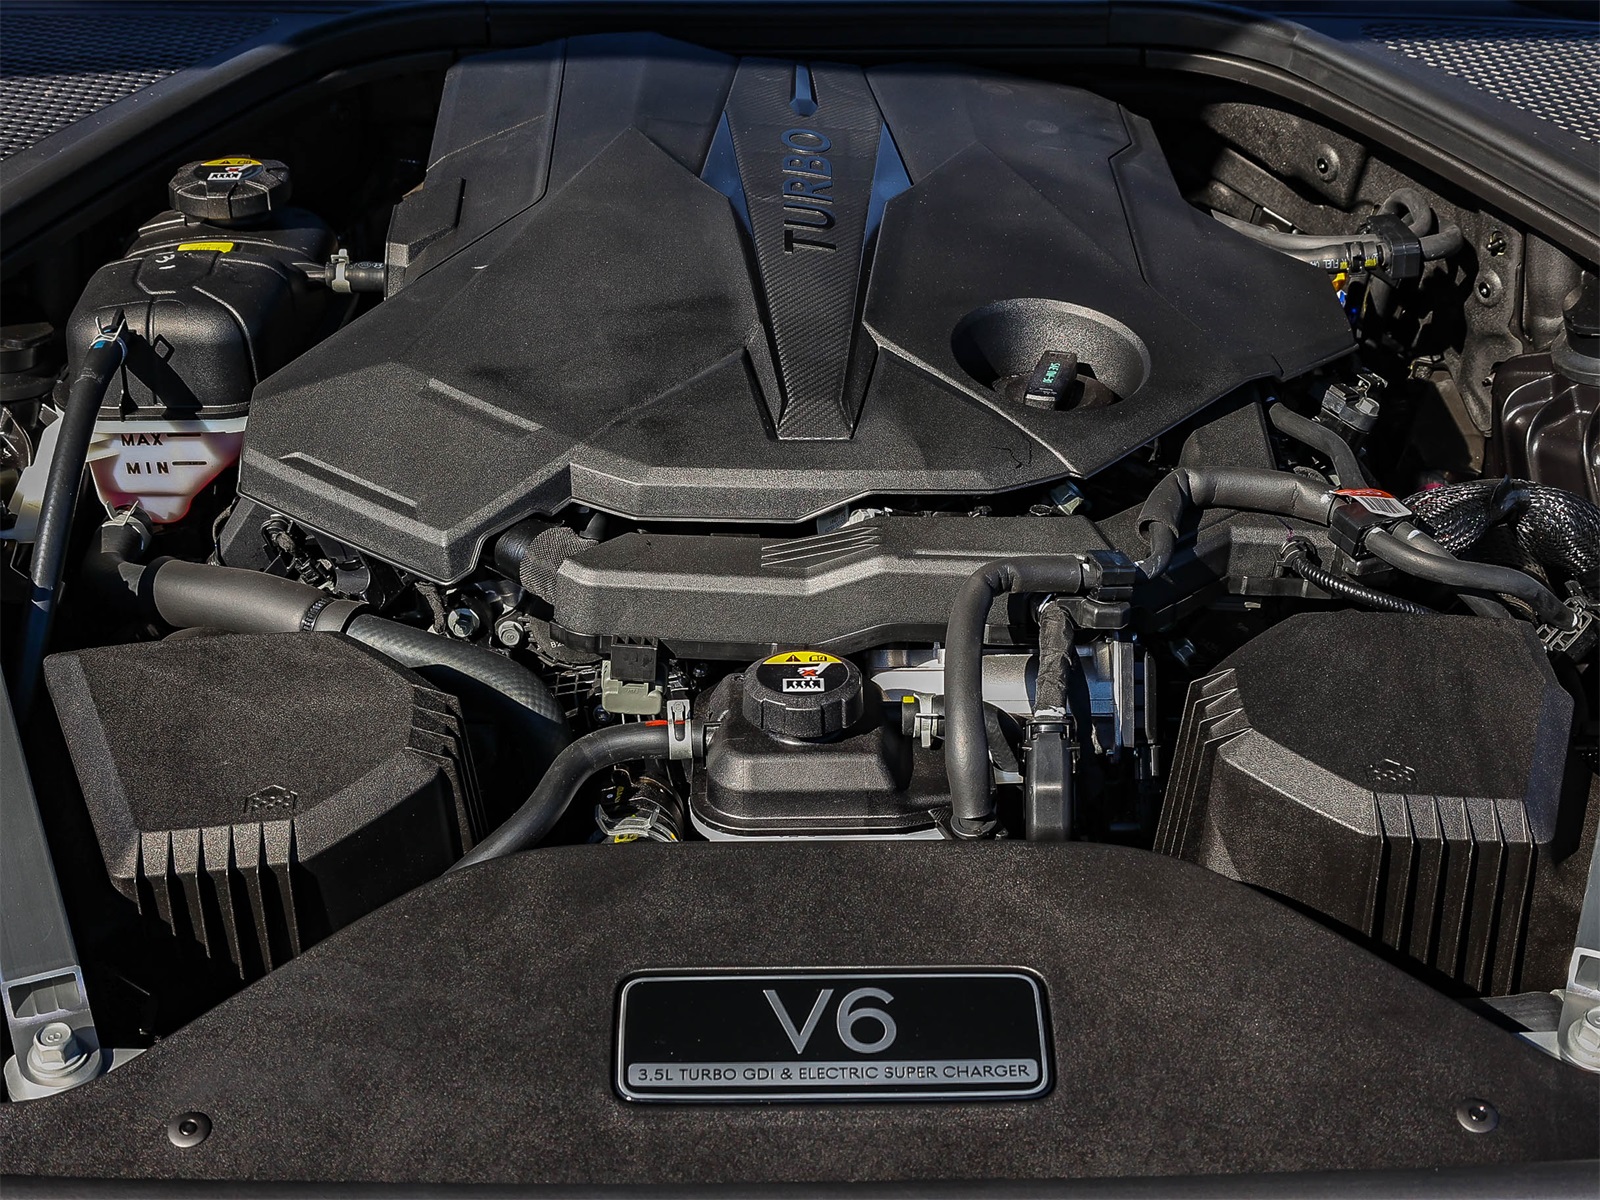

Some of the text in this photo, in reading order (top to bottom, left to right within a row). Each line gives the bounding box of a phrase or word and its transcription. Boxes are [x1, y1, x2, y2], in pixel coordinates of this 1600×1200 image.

[781, 128, 837, 254] TURBO
[121, 433, 163, 446] MAX
[126, 461, 170, 475] MIN
[763, 987, 897, 1055] V6
[638, 1064, 1030, 1082] 3.5L TURBO GDI & ELECTRIC SUPER CHARGER
